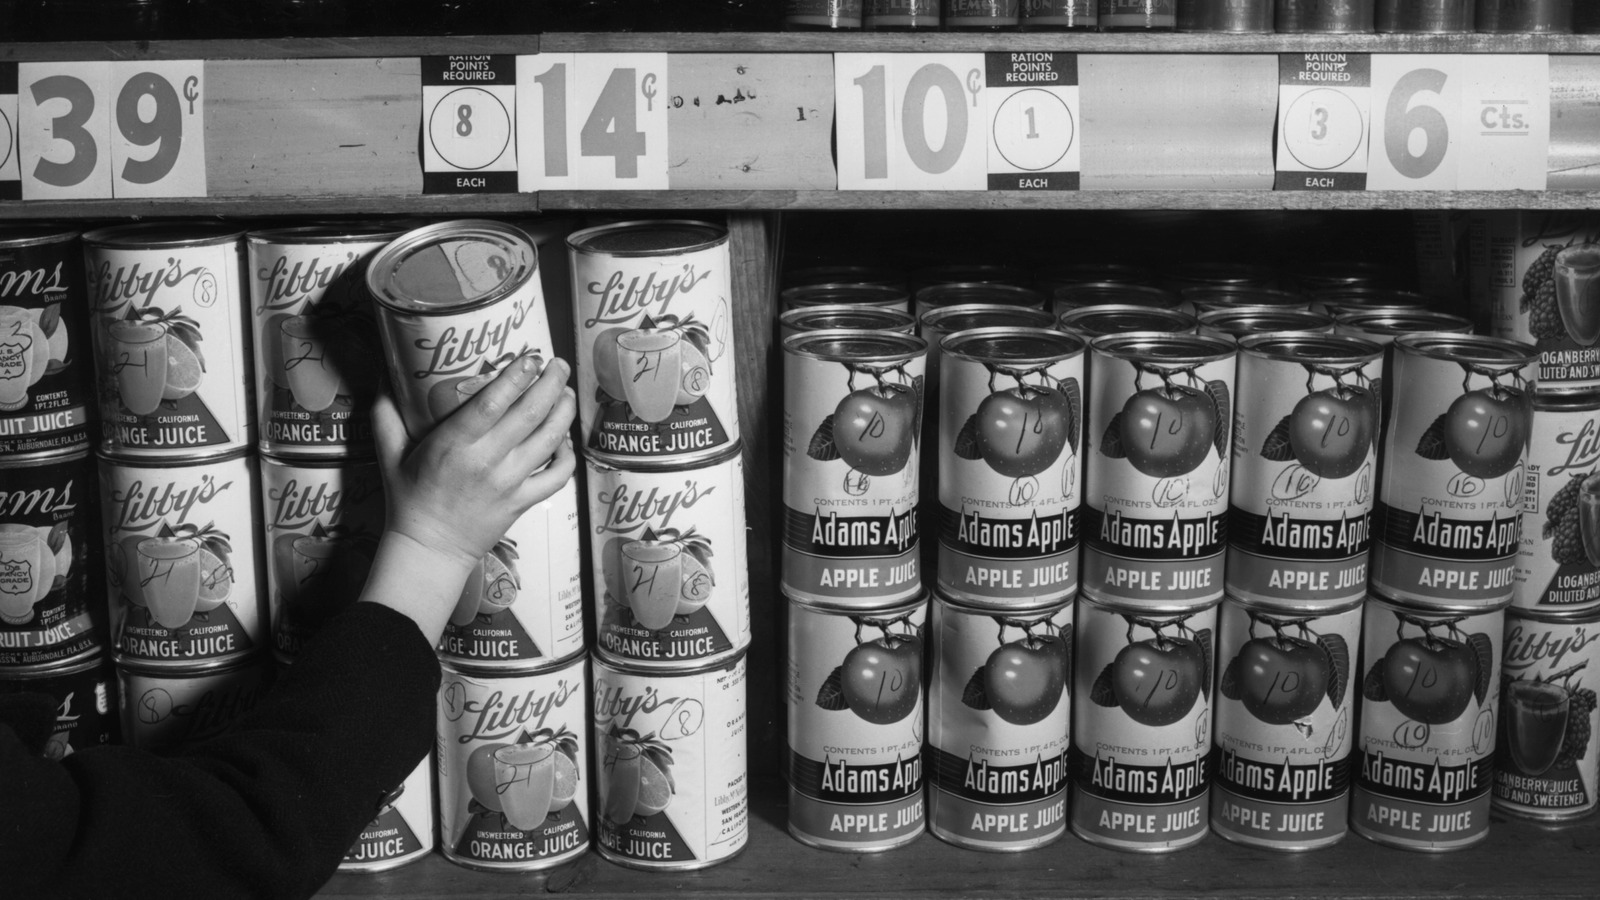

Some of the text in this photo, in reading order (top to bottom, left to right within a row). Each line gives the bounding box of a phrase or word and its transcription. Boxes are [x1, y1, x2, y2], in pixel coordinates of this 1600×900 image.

[450, 61, 489, 71] POINTS
[1011, 53, 1053, 62] RATION
[1012, 62, 1052, 72] POINTS
[1304, 53, 1346, 62] RATION
[1306, 62, 1346, 72] POINTS
[443, 71, 496, 81] REQUIRED
[1006, 72, 1058, 82] REQUIRED
[1299, 72, 1351, 82] REQUIRED
[456, 104, 472, 137] 8
[1024, 106, 1040, 139] 1
[1311, 107, 1329, 140] 3
[1384, 68, 1530, 179] 6 Cts.
[456, 178, 486, 188] EACH
[1019, 178, 1048, 188] EACH
[1305, 178, 1334, 188] EACH
[585, 263, 712, 329] Libby's
[414, 296, 536, 379] Libby's
[1539, 349, 1600, 365] OGANBERRY
[1569, 365, 1588, 378] AND
[36, 391, 68, 402] CONTENTS
[29, 410, 74, 433] JUICE
[158, 414, 200, 424] CALIFORNIA
[604, 418, 708, 432] UNSWEETENED CALIFORNIA
[154, 425, 207, 446] JUICE
[266, 421, 322, 443] ORANGE
[600, 428, 714, 453] ORANGE JUICE
[109, 474, 234, 535] Libby's
[595, 480, 716, 535] Libby's
[814, 498, 868, 507] CONTENTS
[961, 496, 1012, 509] CONTENTS
[1103, 495, 1152, 508] CONTENTS
[1266, 498, 1322, 509] CONTENTS
[1421, 496, 1476, 510] CONTENTS
[812, 506, 881, 546] Adams
[958, 504, 1023, 548] Adams
[1100, 503, 1164, 549] Adams
[1262, 507, 1333, 549] Adams
[1413, 504, 1483, 549] Adams
[820, 559, 916, 588] APPLE JUICE
[965, 562, 1069, 588] APPLE JUICE
[1105, 566, 1211, 591] APPLE JUICE
[1268, 564, 1365, 591] APPLE JUICE
[1418, 565, 1515, 590] APPLE JUICE
[1549, 590, 1585, 602] DILUTED
[35, 622, 75, 646] JUICE
[126, 624, 229, 637] UNSWEETENED CALIFORNIA
[473, 629, 512, 637] CALIFORNIA
[610, 624, 709, 638] UNSWEETENED CALIFORNIA
[123, 634, 235, 657] ORANGE JUICE
[468, 640, 519, 658] JUICE
[606, 633, 715, 659] ORANGE JUICE
[458, 679, 580, 744] Libby's
[823, 746, 877, 755] CONTENTS
[969, 744, 1020, 757] CONTENTS
[1096, 742, 1148, 756] CONTENTS
[822, 754, 889, 793] Adams
[964, 751, 1029, 794] Adams
[1092, 749, 1157, 794] Adams
[1219, 741, 1275, 791] Adams
[1361, 743, 1424, 791] Adams
[1550, 779, 1579, 793] JUICE
[1511, 791, 1585, 807] AND SWEETENED
[830, 799, 923, 833] APPLE JUICE
[971, 800, 1064, 833] APPLE JUICE
[1099, 806, 1200, 834] APPLE JUICE
[1221, 801, 1324, 832] APPLE JUICE
[1367, 803, 1472, 832] APPLE JUICE
[360, 828, 398, 839] CALIFORNIA
[477, 821, 575, 840] UNSWEETENED CALIFORNIA
[629, 828, 666, 839] CALIFORNIA
[355, 837, 404, 860] JUICE
[471, 829, 580, 860] ORANGE JUICE
[625, 840, 672, 859] JUICE
